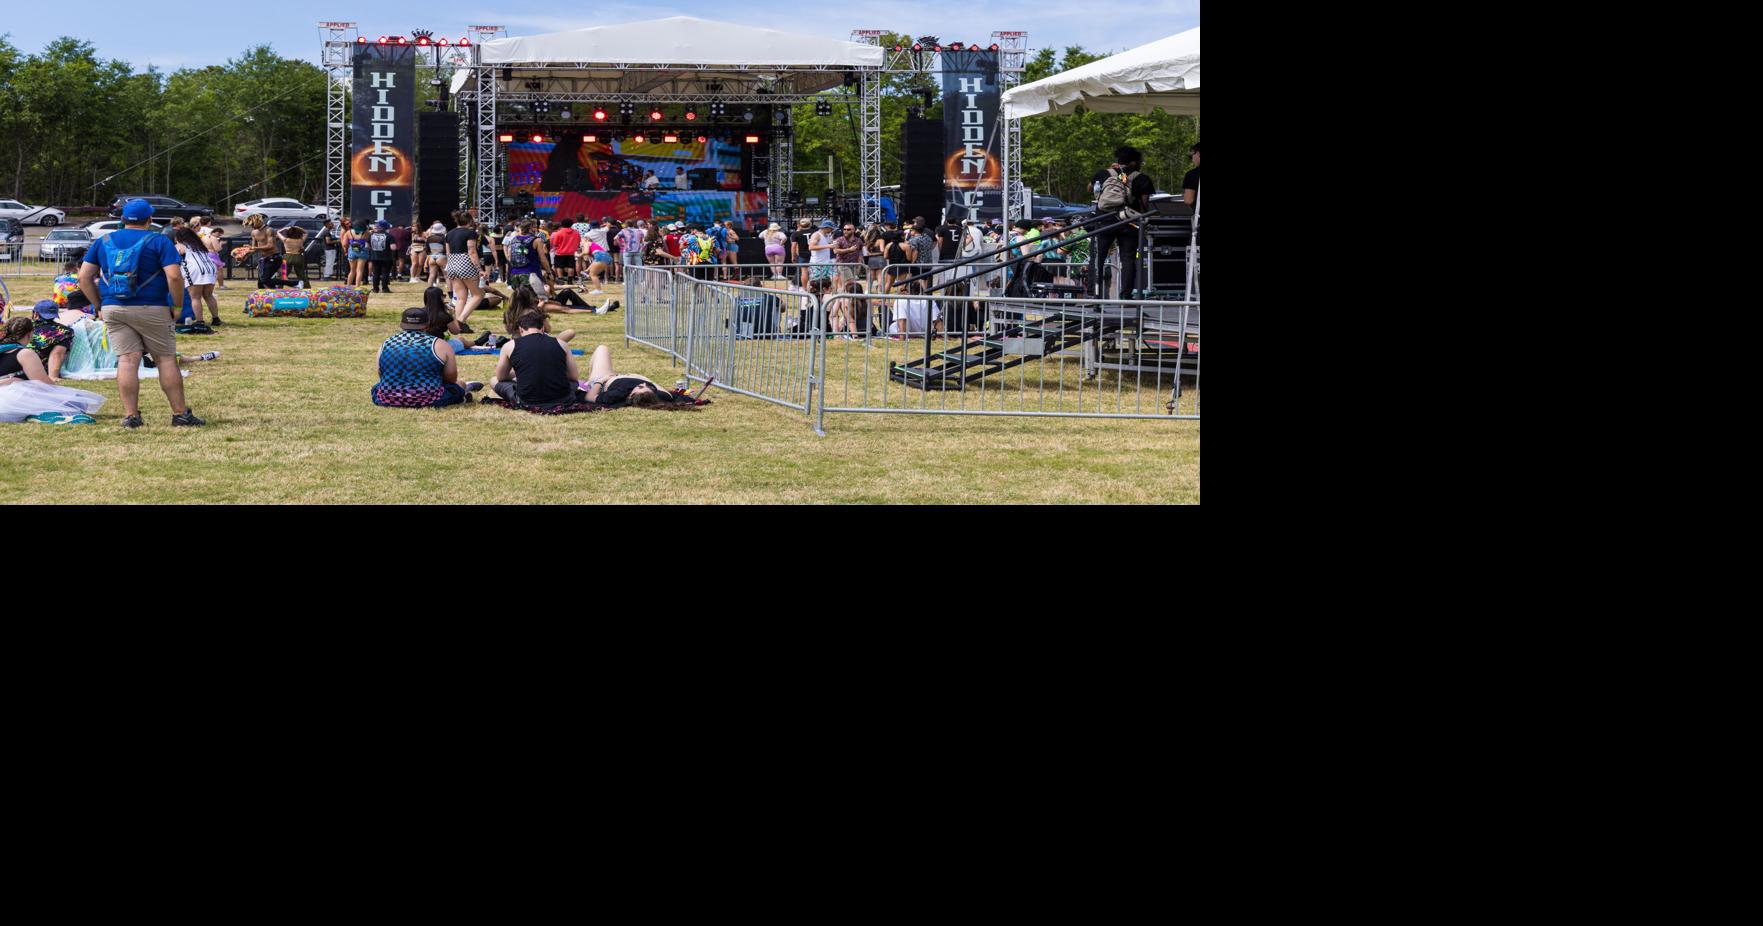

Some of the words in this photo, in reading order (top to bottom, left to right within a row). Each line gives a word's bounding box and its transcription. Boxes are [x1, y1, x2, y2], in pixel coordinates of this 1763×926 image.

[368, 72, 396, 172] HIDDEN
[958, 77, 986, 174] HIDDEN
[370, 190, 392, 226] CI
[963, 191, 984, 226] CI
